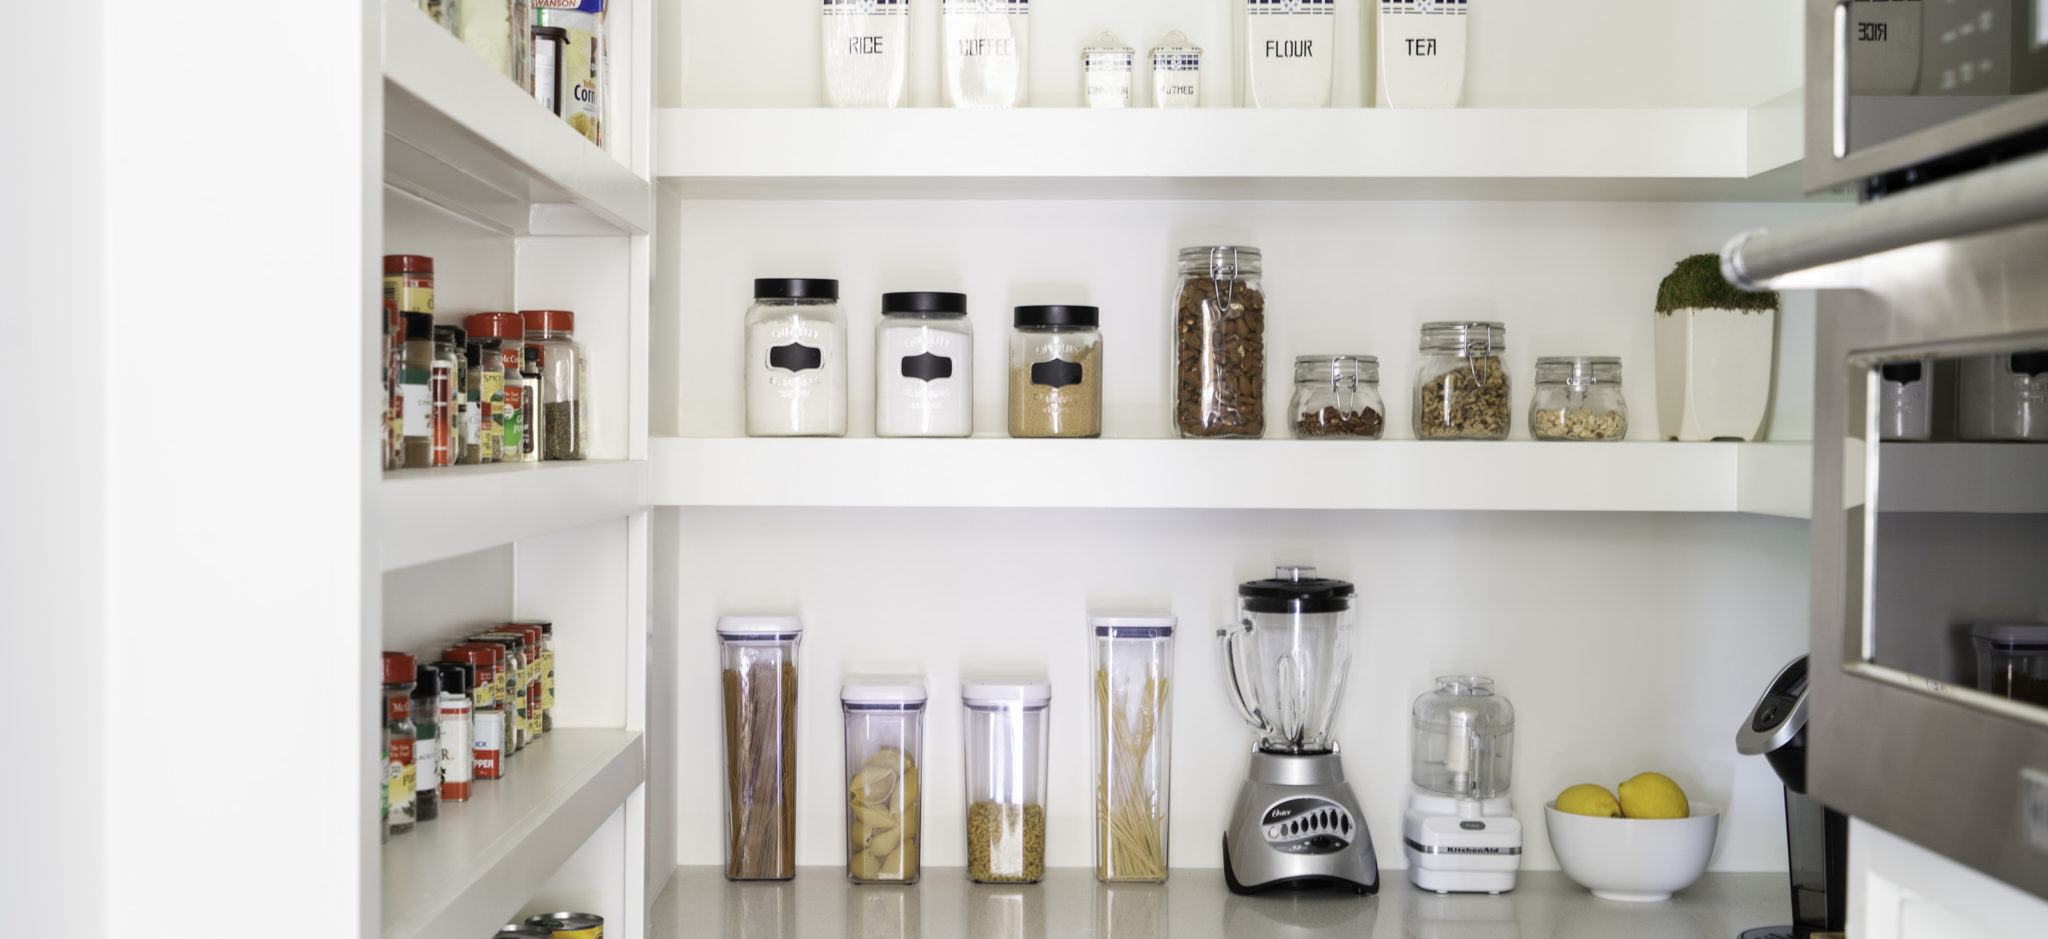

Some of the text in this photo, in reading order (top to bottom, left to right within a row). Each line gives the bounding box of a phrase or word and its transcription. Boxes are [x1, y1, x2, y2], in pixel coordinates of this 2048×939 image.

[849, 36, 883, 54] RICE
[959, 38, 1011, 56] COFFEE
[1266, 40, 1312, 58] FLOUR
[1405, 38, 1436, 56] TEA
[574, 84, 596, 104] Corn
[1161, 86, 1194, 95] UTMEG
[473, 759, 494, 769] PPER
[1272, 809, 1291, 817] Oster
